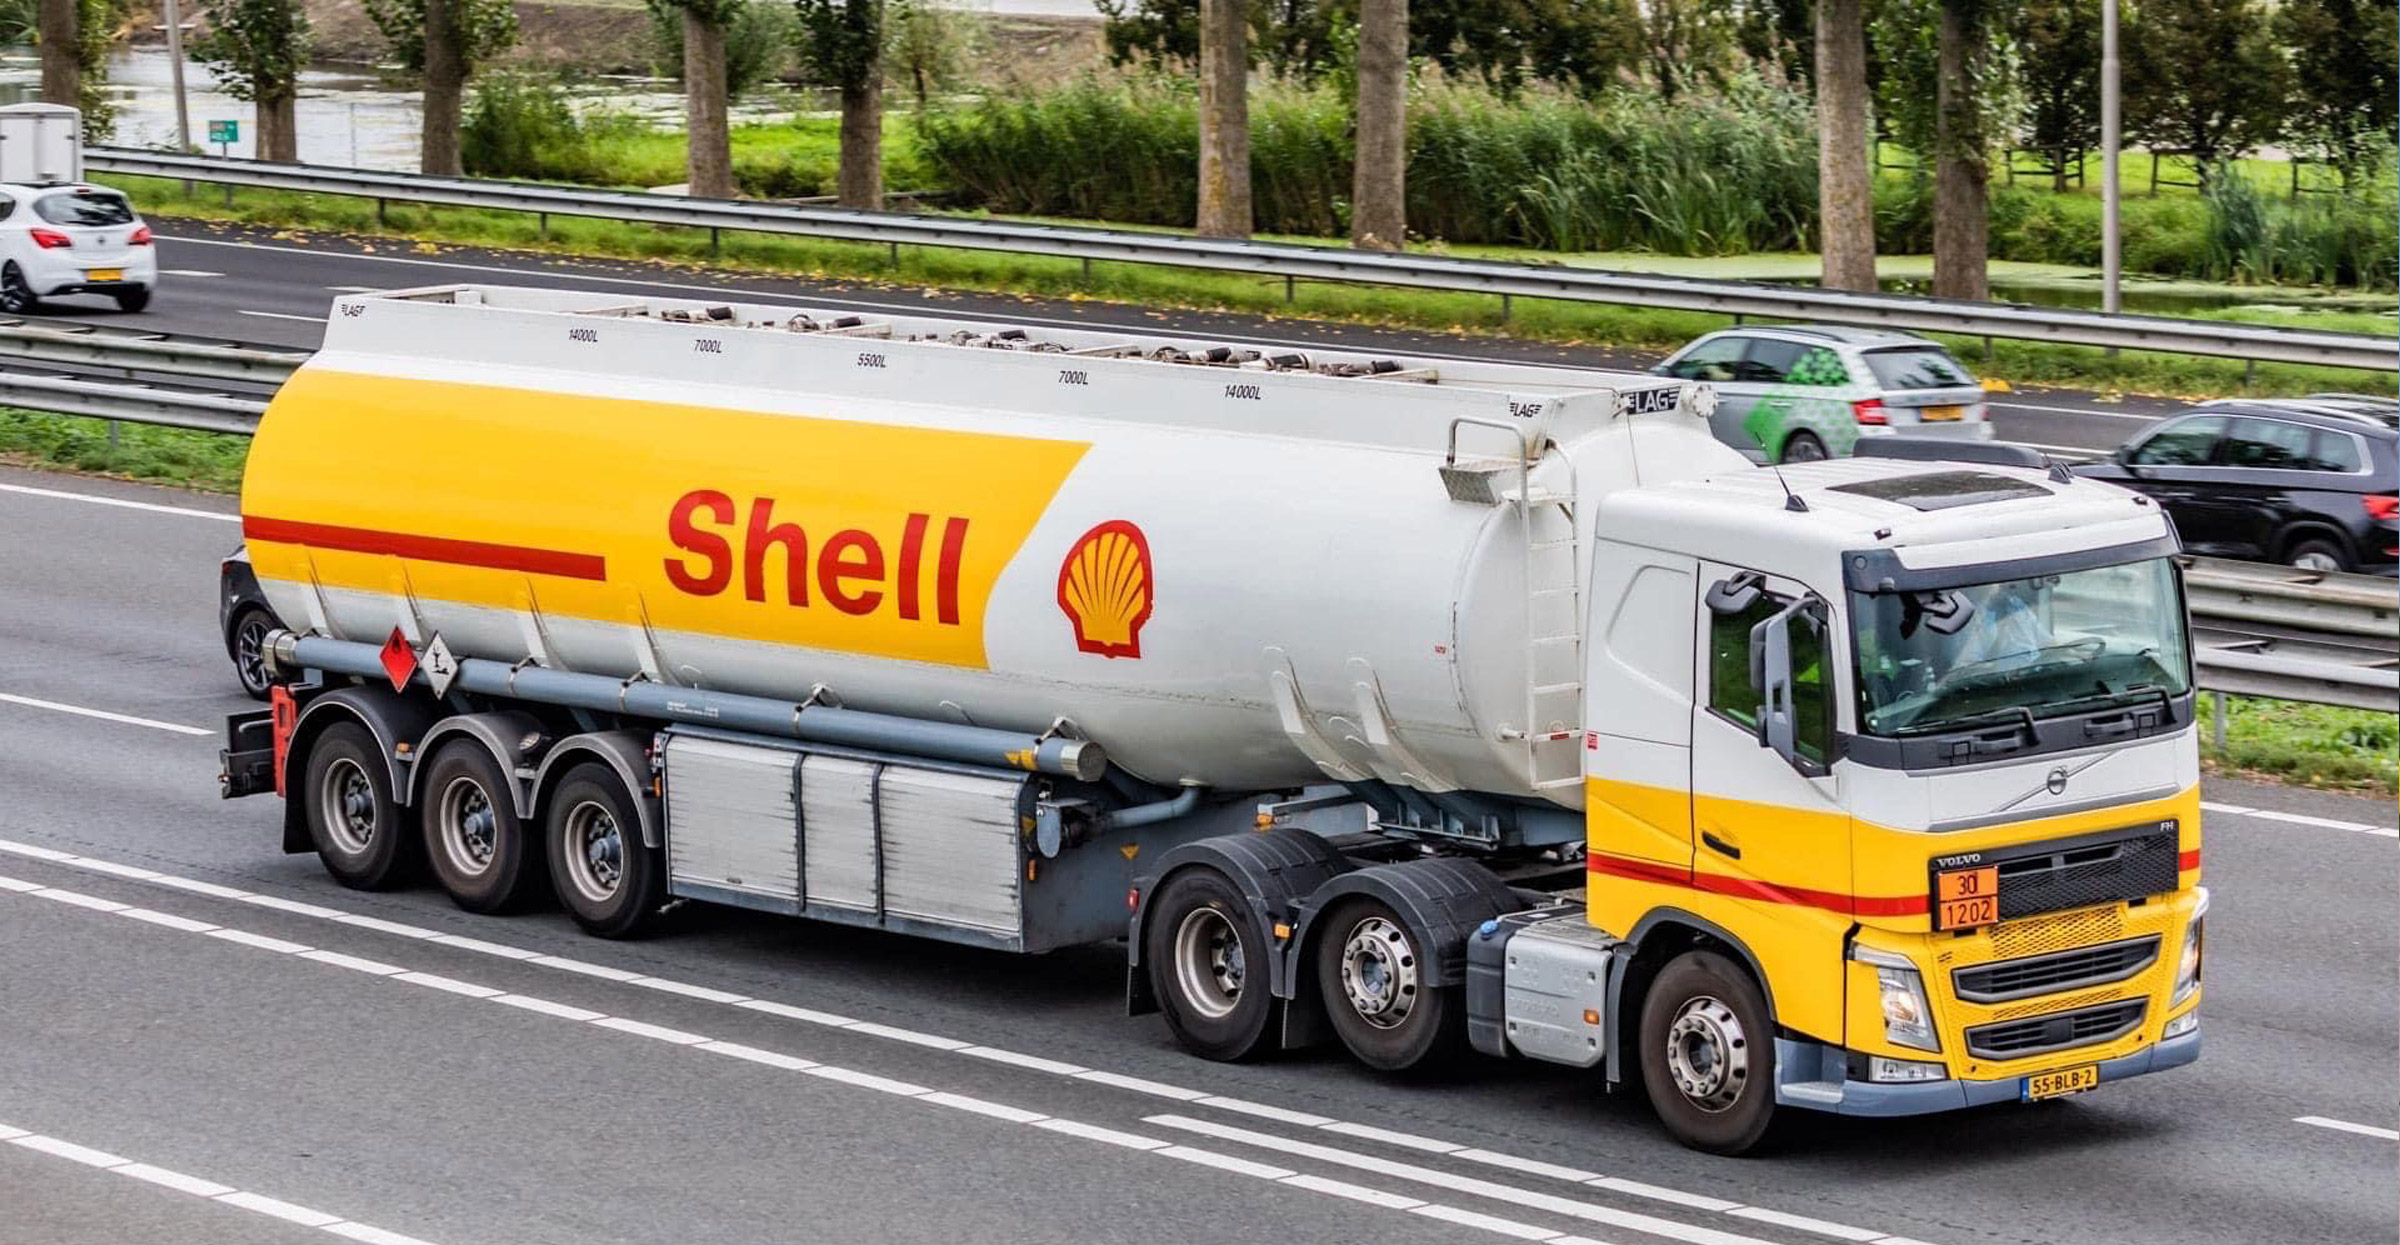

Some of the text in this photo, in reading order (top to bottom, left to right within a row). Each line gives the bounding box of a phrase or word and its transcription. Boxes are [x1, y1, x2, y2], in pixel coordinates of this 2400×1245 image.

[568, 329, 598, 342] 14000L
[694, 339, 722, 353] 7000L
[857, 353, 886, 368] 5500L
[1058, 370, 1089, 385] 7000L
[1224, 385, 1261, 400] 14000L
[1630, 388, 1676, 413] LAG
[1510, 402, 1541, 418] LAG
[663, 489, 970, 625] Shell
[1937, 853, 1981, 867] VOLVO
[1957, 872, 1978, 895] 30
[1947, 899, 1990, 926] 1202
[2032, 1069, 2092, 1095] 55-BLB-2
